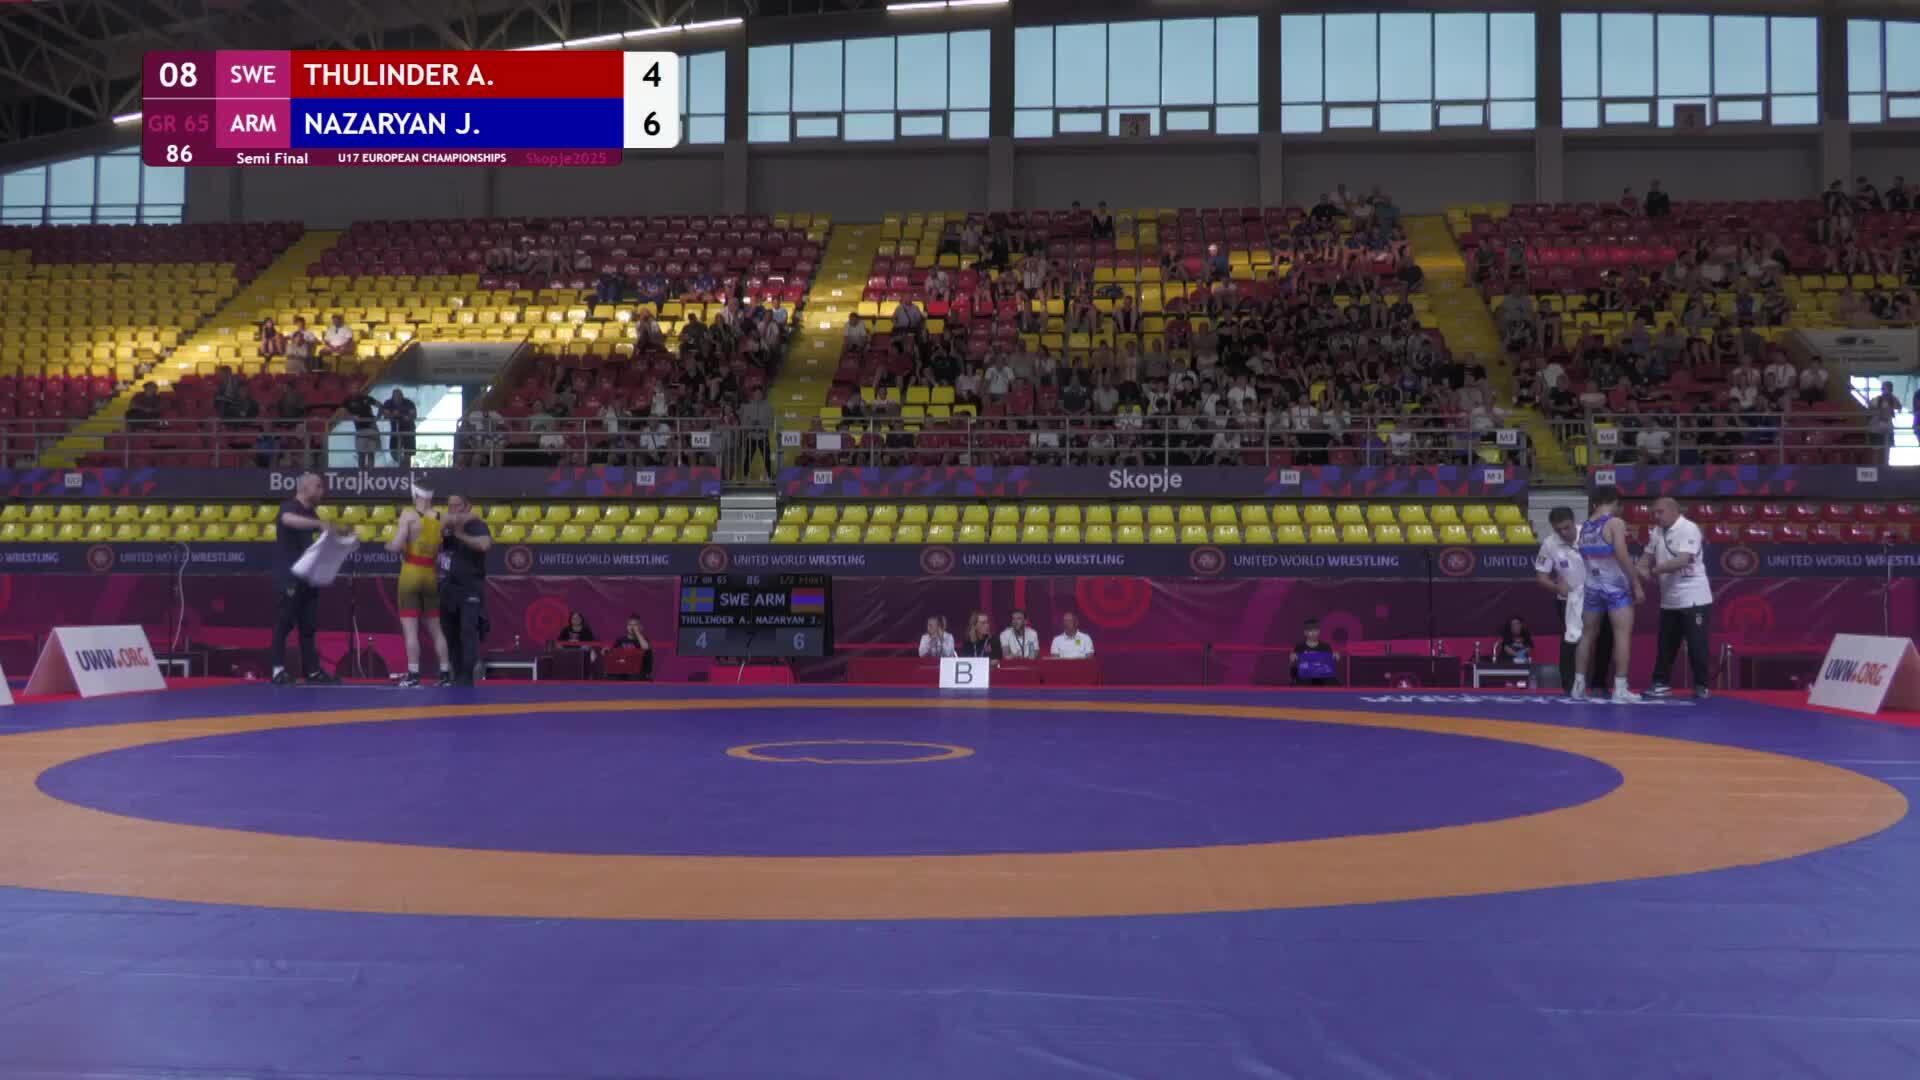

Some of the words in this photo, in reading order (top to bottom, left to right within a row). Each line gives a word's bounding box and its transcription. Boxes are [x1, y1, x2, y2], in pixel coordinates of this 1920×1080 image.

[326, 472, 427, 494] Trajkovs
[1108, 470, 1183, 491] Skopje
[191, 552, 245, 563] WRESTLING
[362, 552, 398, 563] WORLD
[539, 554, 574, 565] UNITED
[576, 554, 611, 565] WORLD
[613, 554, 669, 565] WRESTLING
[734, 554, 770, 566] UNITED
[771, 554, 806, 566] WORLD
[808, 554, 865, 566] WRESTLING
[963, 554, 1005, 566] UNITED
[1008, 554, 1051, 566] WORLD
[1054, 554, 1125, 566] WRESTLING
[1233, 555, 1277, 567] UNITED
[1280, 555, 1325, 567] WORLD
[1327, 555, 1399, 567] WRESTLING
[1483, 555, 1528, 567] UNITED
[1767, 555, 1813, 567] UNITED
[1815, 555, 1862, 567] WORLD
[720, 593, 750, 606] SWE
[754, 593, 786, 606] ARM
[682, 616, 734, 625] THULINDER
[756, 616, 805, 625] NAZARYAN
[696, 631, 708, 648] 4
[793, 632, 805, 649] 6
[76, 647, 149, 671] UWW.ORG
[955, 661, 973, 684] B
[1824, 658, 1888, 686] UWW.ORG
